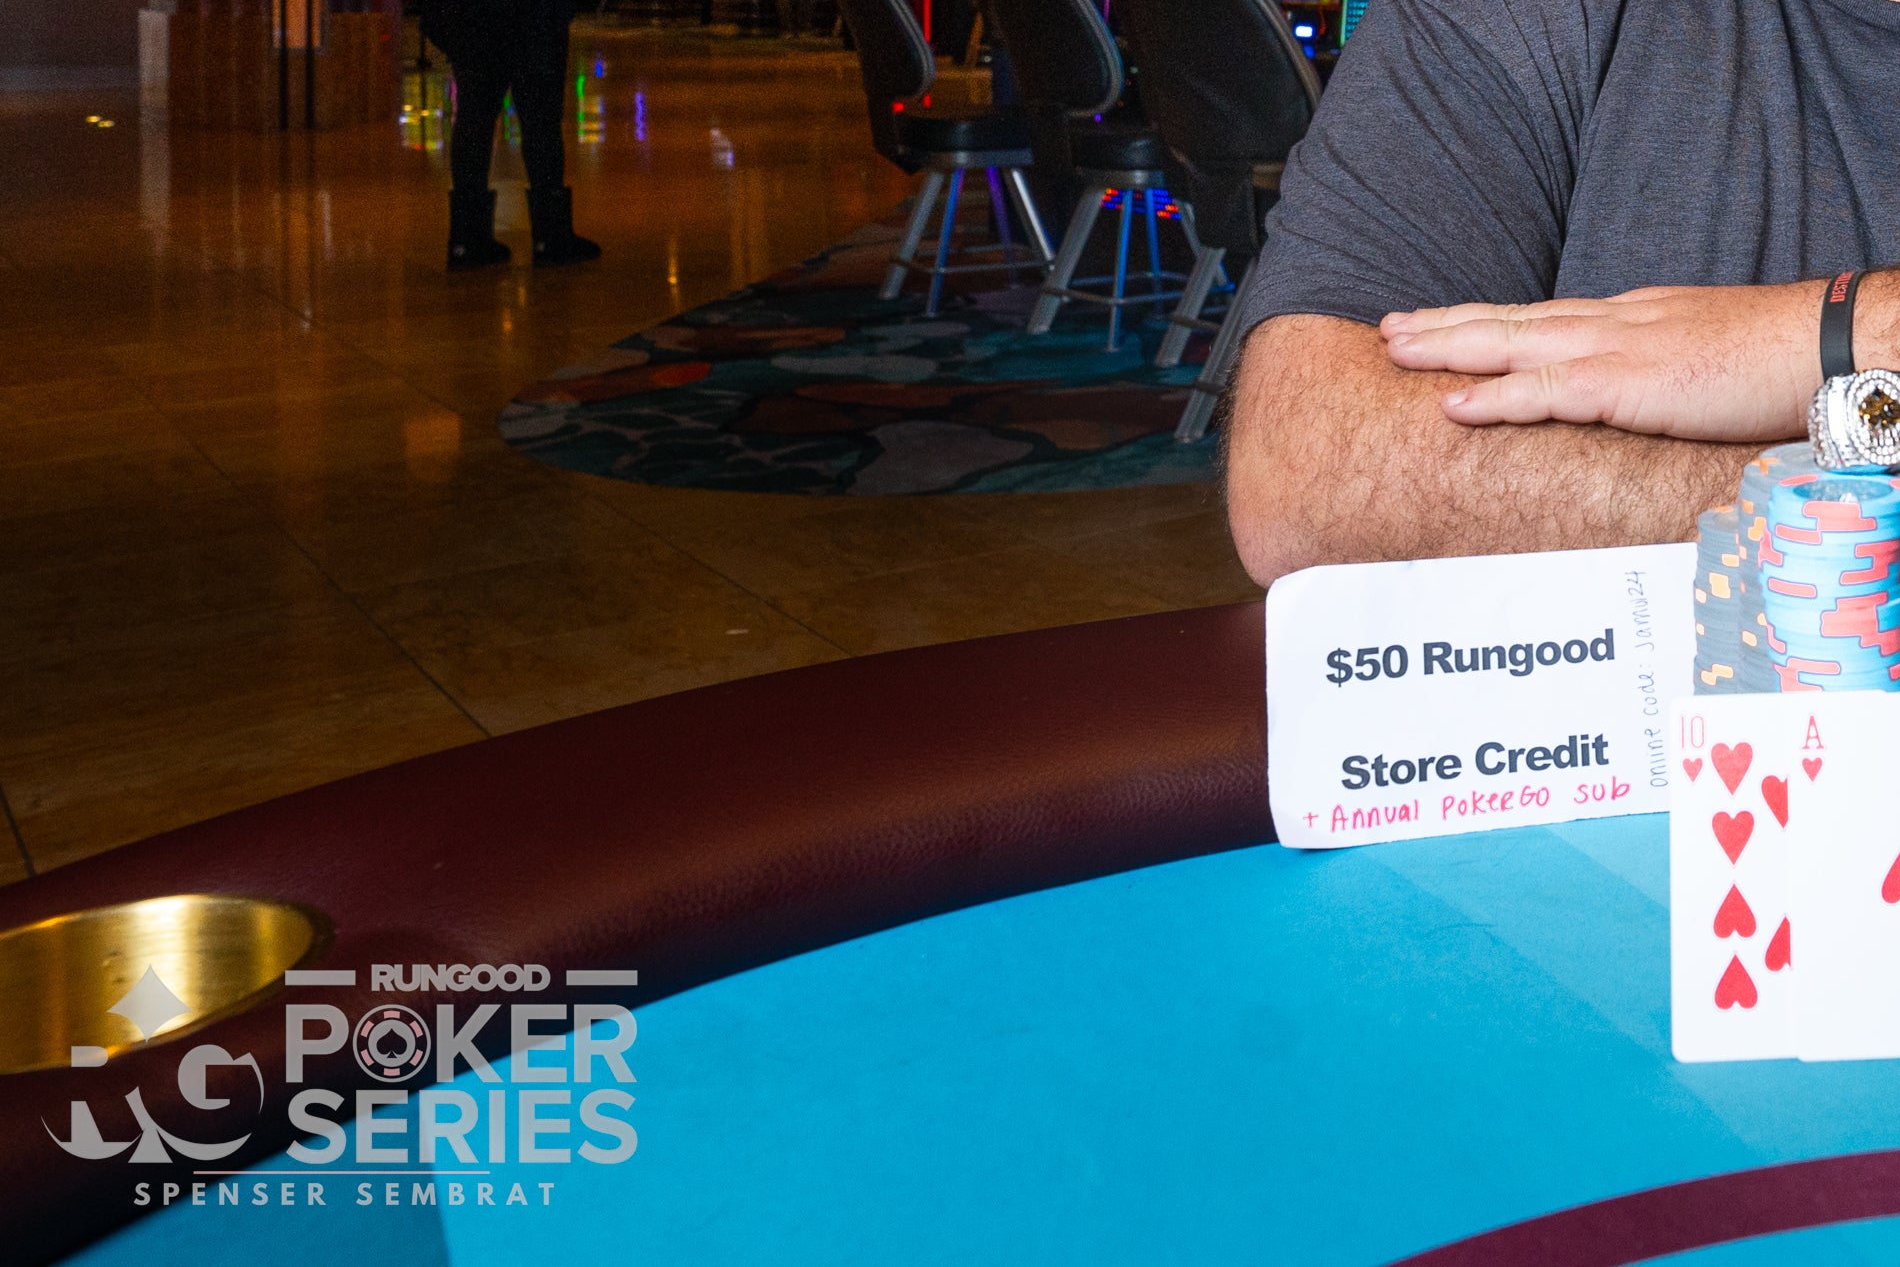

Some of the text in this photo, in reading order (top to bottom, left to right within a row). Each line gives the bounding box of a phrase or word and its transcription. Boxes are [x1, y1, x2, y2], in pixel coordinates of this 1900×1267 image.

[1326, 628, 1615, 688] $50 Rungood
[1681, 715, 1705, 750] 10
[1802, 715, 1825, 750] A
[1341, 734, 1610, 790] Store Credit
[1331, 798, 1420, 833] Annual
